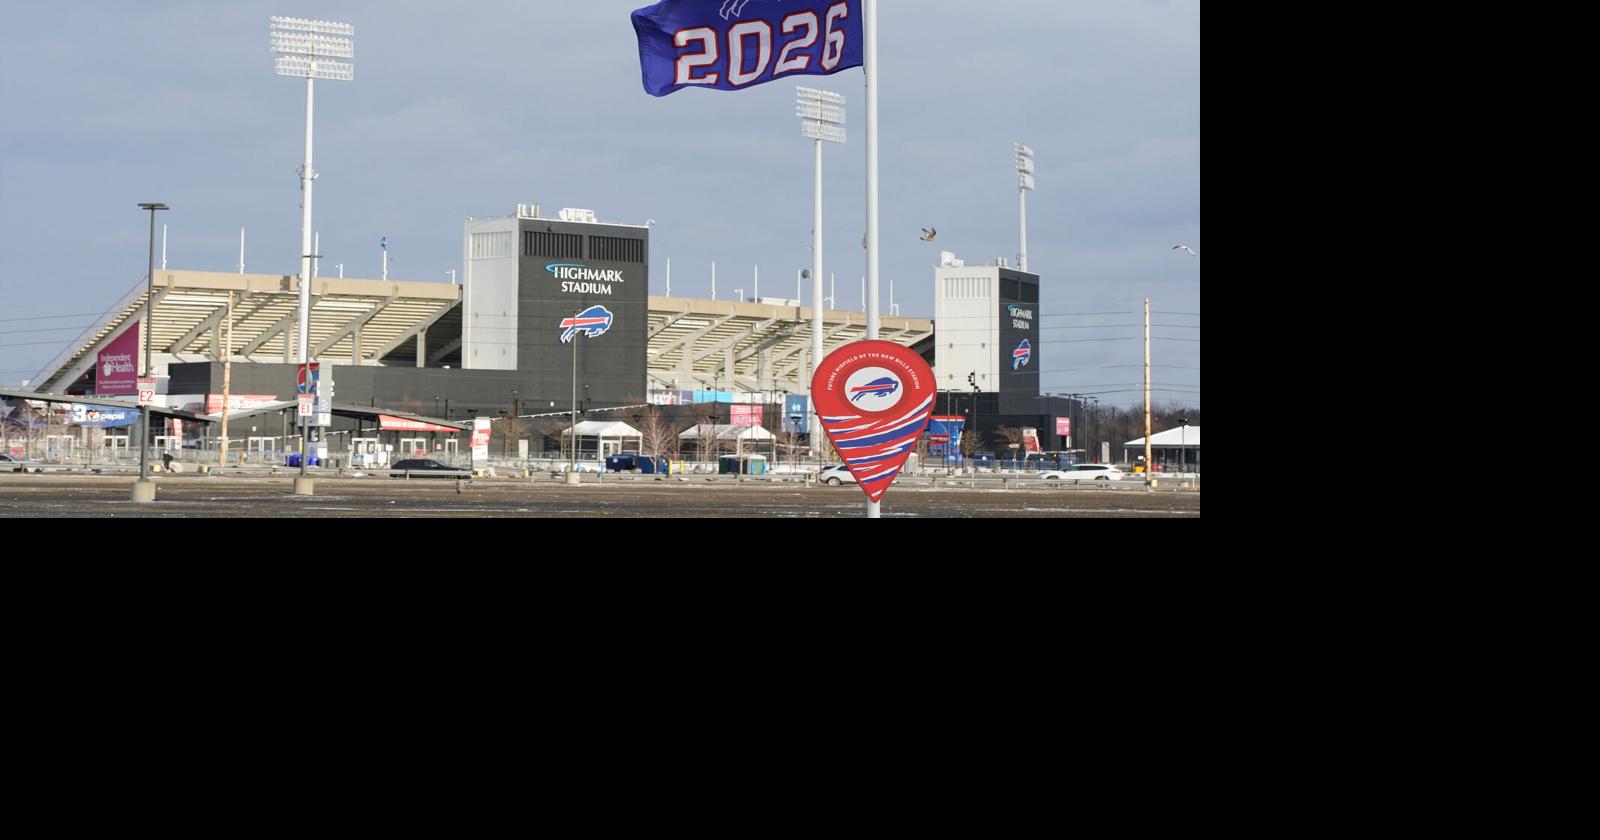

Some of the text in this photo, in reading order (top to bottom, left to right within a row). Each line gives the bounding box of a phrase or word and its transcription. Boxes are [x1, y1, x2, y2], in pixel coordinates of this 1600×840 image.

[673, 1, 848, 87] 2026
[554, 266, 624, 282] HIGHMARK
[561, 281, 612, 295] STADIUM
[101, 353, 131, 362] Independent
[111, 361, 134, 372] Health
[828, 371, 837, 390] FUTURE
[834, 355, 858, 371] MIDFIELD
[895, 358, 910, 370] BILLS
[140, 391, 153, 401] E2
[73, 405, 124, 421] 3 pepsi
[301, 404, 310, 414] E1
